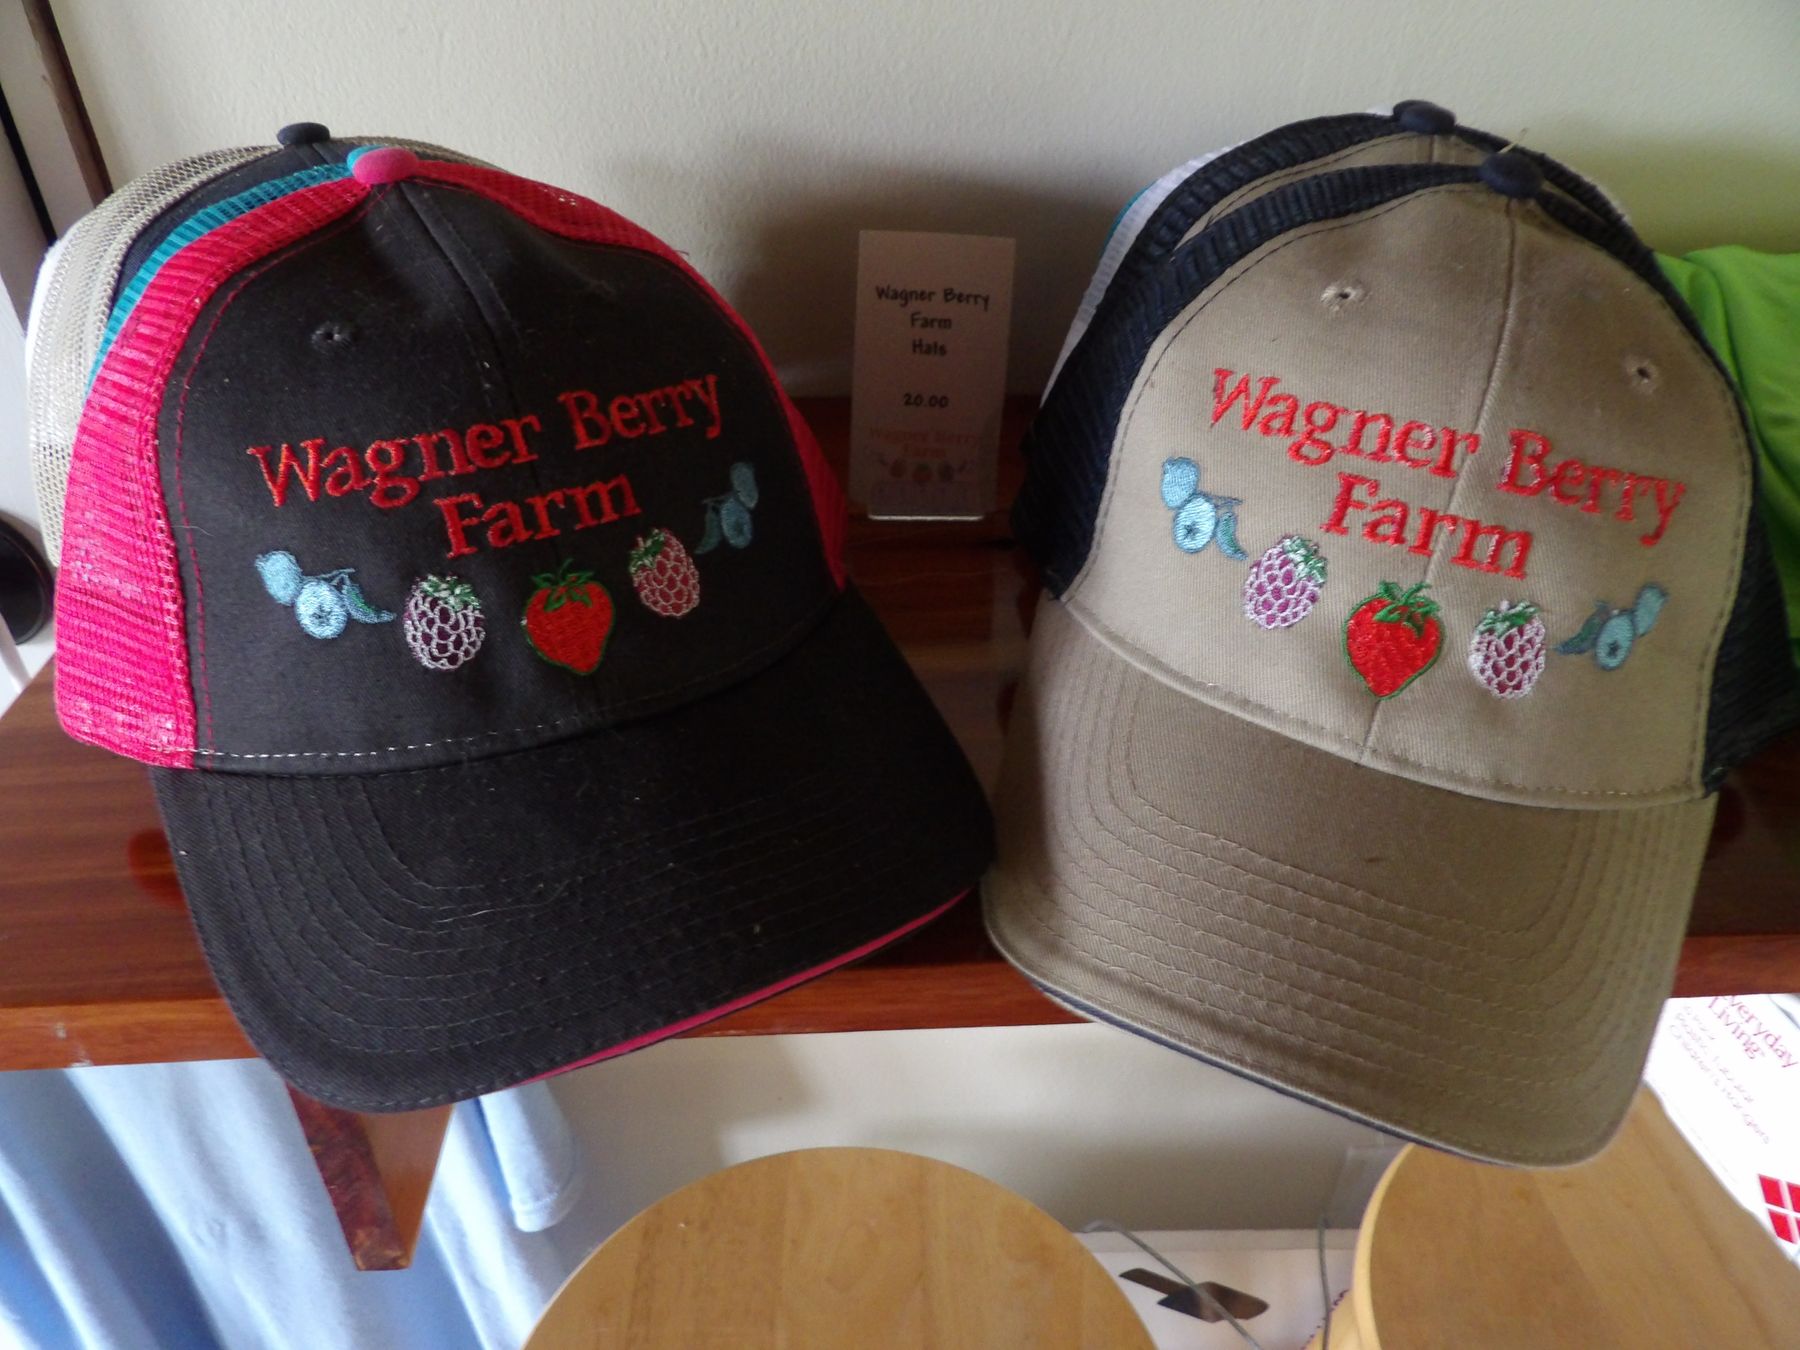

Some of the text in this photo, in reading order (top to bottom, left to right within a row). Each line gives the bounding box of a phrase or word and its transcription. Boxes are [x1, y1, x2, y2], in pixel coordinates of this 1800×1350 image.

[875, 284, 990, 311] Wagner Berry
[910, 311, 953, 329] Farm
[903, 392, 949, 409] 20.00
[246, 373, 723, 510] Wagner Berry
[1210, 366, 1687, 547] Wagner Berry
[432, 473, 643, 560] Farm
[1319, 471, 1533, 581] Farm
[1707, 996, 1757, 1060] Living
[1722, 995, 1799, 1068] veryday
